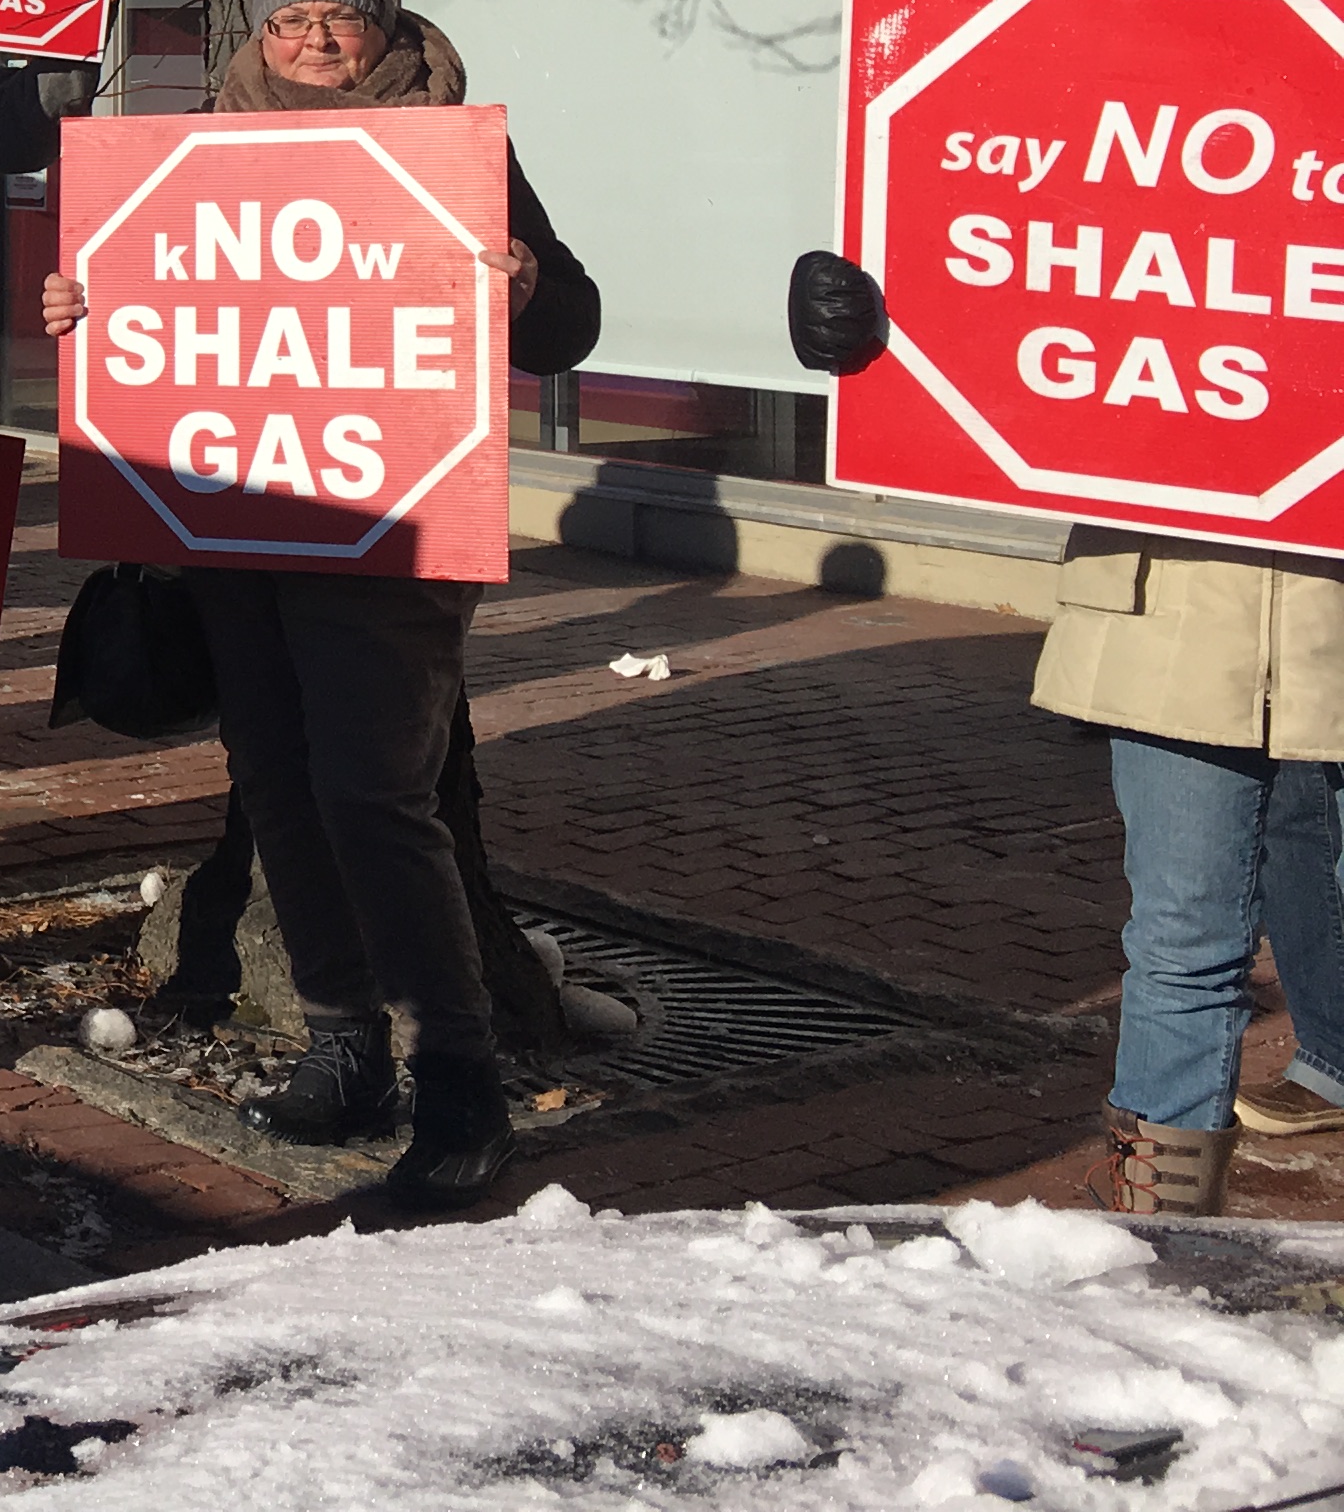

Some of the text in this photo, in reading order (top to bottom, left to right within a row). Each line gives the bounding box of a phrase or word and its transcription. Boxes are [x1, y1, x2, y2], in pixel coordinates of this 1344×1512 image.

[940, 131, 1066, 193] say
[1083, 100, 1275, 195] NO
[154, 199, 404, 282] kNOw
[945, 214, 1344, 322] SHALE
[104, 305, 455, 389] SHALE
[1017, 326, 1270, 422] GAS
[168, 410, 386, 500] GAS
